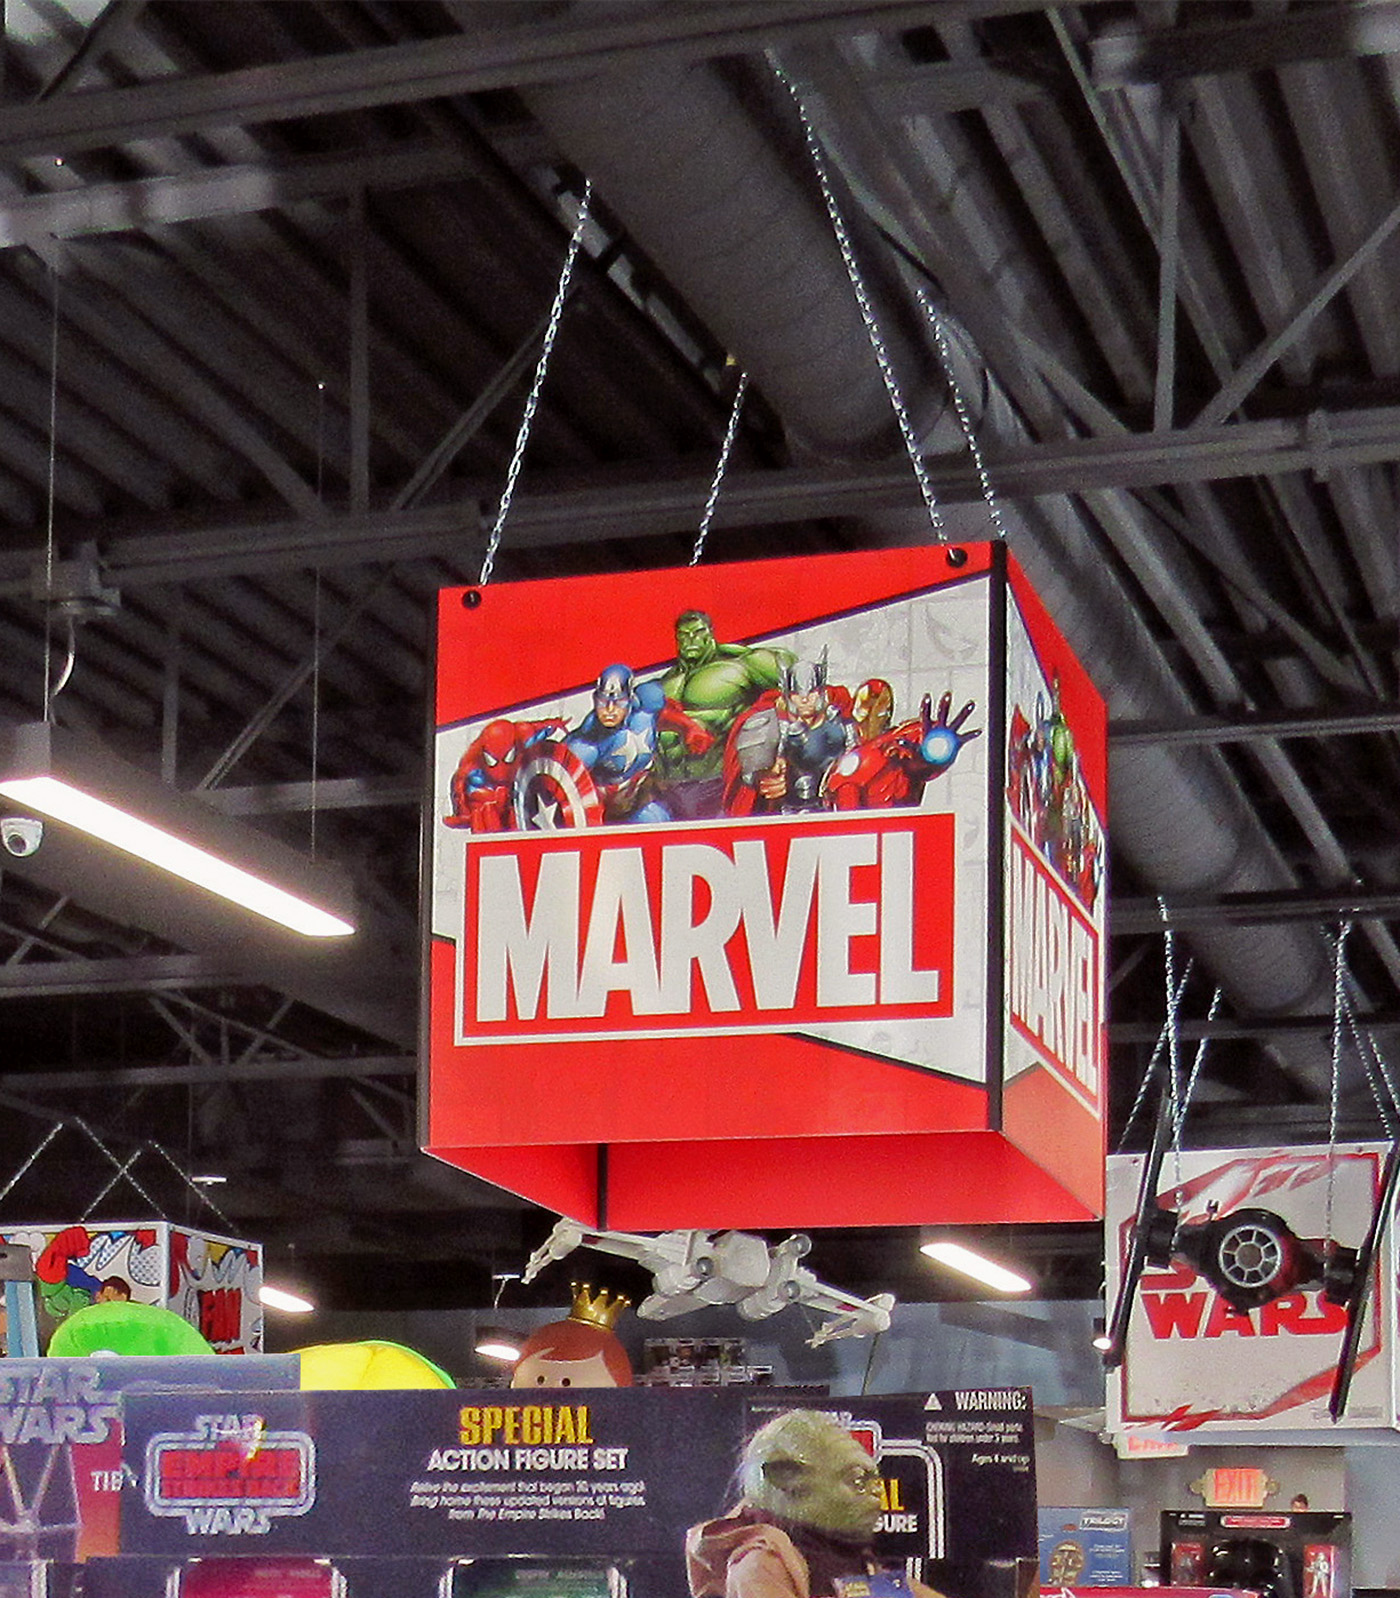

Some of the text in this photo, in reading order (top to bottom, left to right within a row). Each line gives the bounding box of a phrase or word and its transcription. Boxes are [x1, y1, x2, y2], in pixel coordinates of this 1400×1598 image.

[477, 832, 940, 1023] MARVEL
[1012, 841, 1097, 1097] MARVEL
[1141, 1290, 1350, 1340] WARS
[955, 1391, 1027, 1411] WARNING:
[459, 1405, 595, 1446] SPECIAL
[427, 1447, 629, 1471] ACTION FIGURE SET
[186, 1509, 273, 1535] WARS
[872, 1514, 919, 1533] GURE
